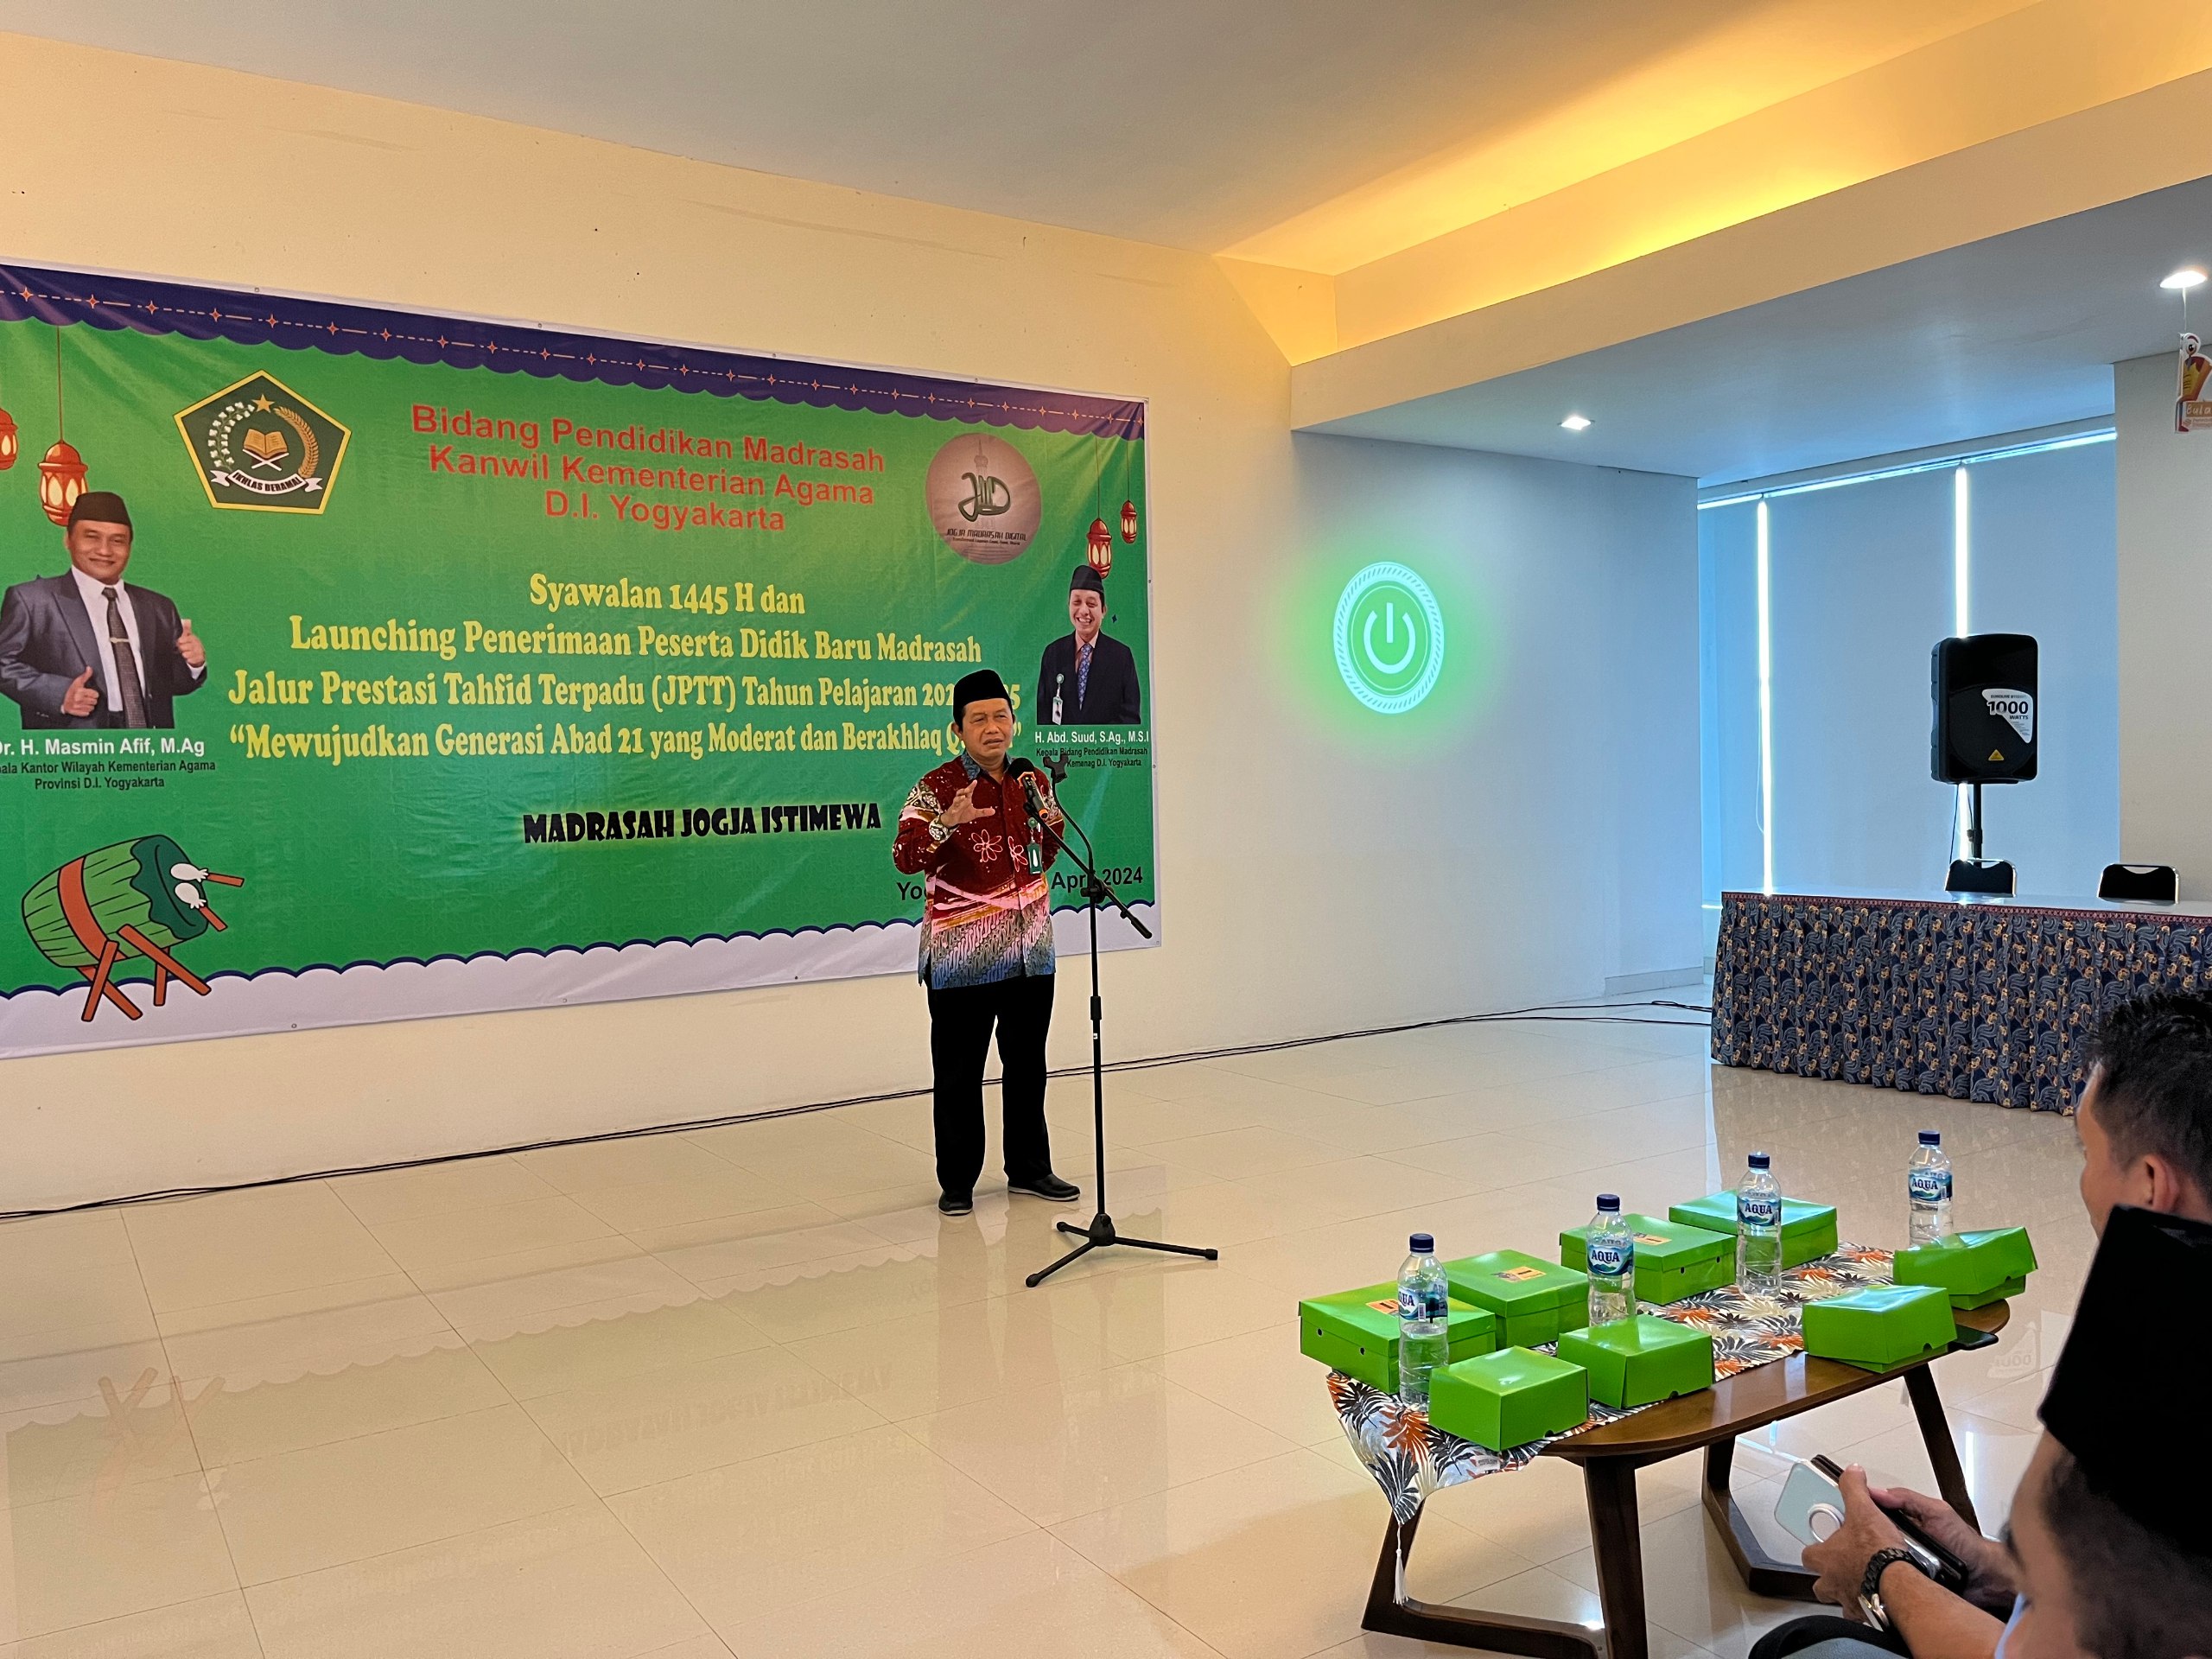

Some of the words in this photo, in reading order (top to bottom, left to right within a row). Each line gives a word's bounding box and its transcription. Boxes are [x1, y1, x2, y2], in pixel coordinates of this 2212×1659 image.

[411, 404, 539, 449] Bidang
[551, 417, 733, 459] Pendidikan
[743, 435, 884, 473] Madrasah
[232, 472, 264, 491] IKHLAS
[264, 476, 302, 492] BERAMAL
[429, 444, 549, 480] Kanwil
[563, 454, 765, 496] Kementerian
[774, 473, 874, 507] Agama
[545, 489, 599, 519] D.I.
[610, 493, 785, 531] Yogyakarta
[967, 529, 1003, 540] MADRASAH
[1005, 531, 1027, 541] DIGITAL
[530, 573, 662, 613] Syawalan
[669, 584, 728, 614] 1445
[734, 582, 754, 613] H
[760, 585, 805, 614] dan
[289, 614, 457, 661] Launching
[463, 620, 632, 656] Penerimaan
[638, 625, 734, 658] Peserta
[740, 628, 809, 659] Didik
[815, 631, 872, 660] Baru
[876, 632, 982, 663] Madrasah
[228, 669, 314, 705] Jalur
[321, 671, 437, 705] Prestasi
[443, 671, 532, 705] Tahfid
[537, 673, 645, 713] Terpadu
[652, 674, 735, 713] (JPTT)
[741, 676, 814, 706] Tahun
[818, 677, 918, 714] Pelajaran
[1987, 701, 2029, 715] 1000
[0, 740, 16, 755] r.
[21, 739, 40, 755] H.
[45, 738, 115, 755] Masmin
[119, 737, 156, 756] Afif,
[161, 737, 205, 757] M.Ag
[230, 723, 429, 766] “Mewujudkan
[435, 722, 544, 756] Generasi
[550, 722, 612, 755] Abad
[618, 728, 645, 755] 21
[650, 729, 703, 760] yang
[708, 721, 795, 753] Moderat
[800, 722, 837, 752] dan
[842, 721, 942, 757] Berakhlaq
[1034, 731, 1045, 743] H.
[1046, 731, 1069, 743] Abd.
[1071, 731, 1097, 744] Suud,
[1099, 731, 1126, 745] S.Ag.,
[1128, 730, 1149, 742] M.S.I
[1036, 747, 1058, 757] Kepala
[1084, 747, 1118, 757] Pendidikan
[1119, 746, 1147, 756] Madrasah
[21, 762, 59, 773] Kantor
[61, 760, 105, 775] Wilayah
[108, 760, 176, 772] Kementerian
[179, 760, 216, 773] Agama
[1096, 759, 1107, 767] D.I.
[1109, 759, 1141, 768] Yogyakarta
[35, 778, 80, 790] Provinsi
[84, 777, 101, 788] D.I.
[105, 776, 165, 791] Yogyakarta
[523, 809, 675, 843] MADRASAH
[680, 806, 757, 837] JOGJA
[760, 803, 882, 834] ISTIMEWA
[1102, 866, 1143, 886] 2024
[1911, 1178, 1939, 1192] AQUA
[1744, 1202, 1773, 1216] AQUA
[1591, 1249, 1621, 1264] AQUA
